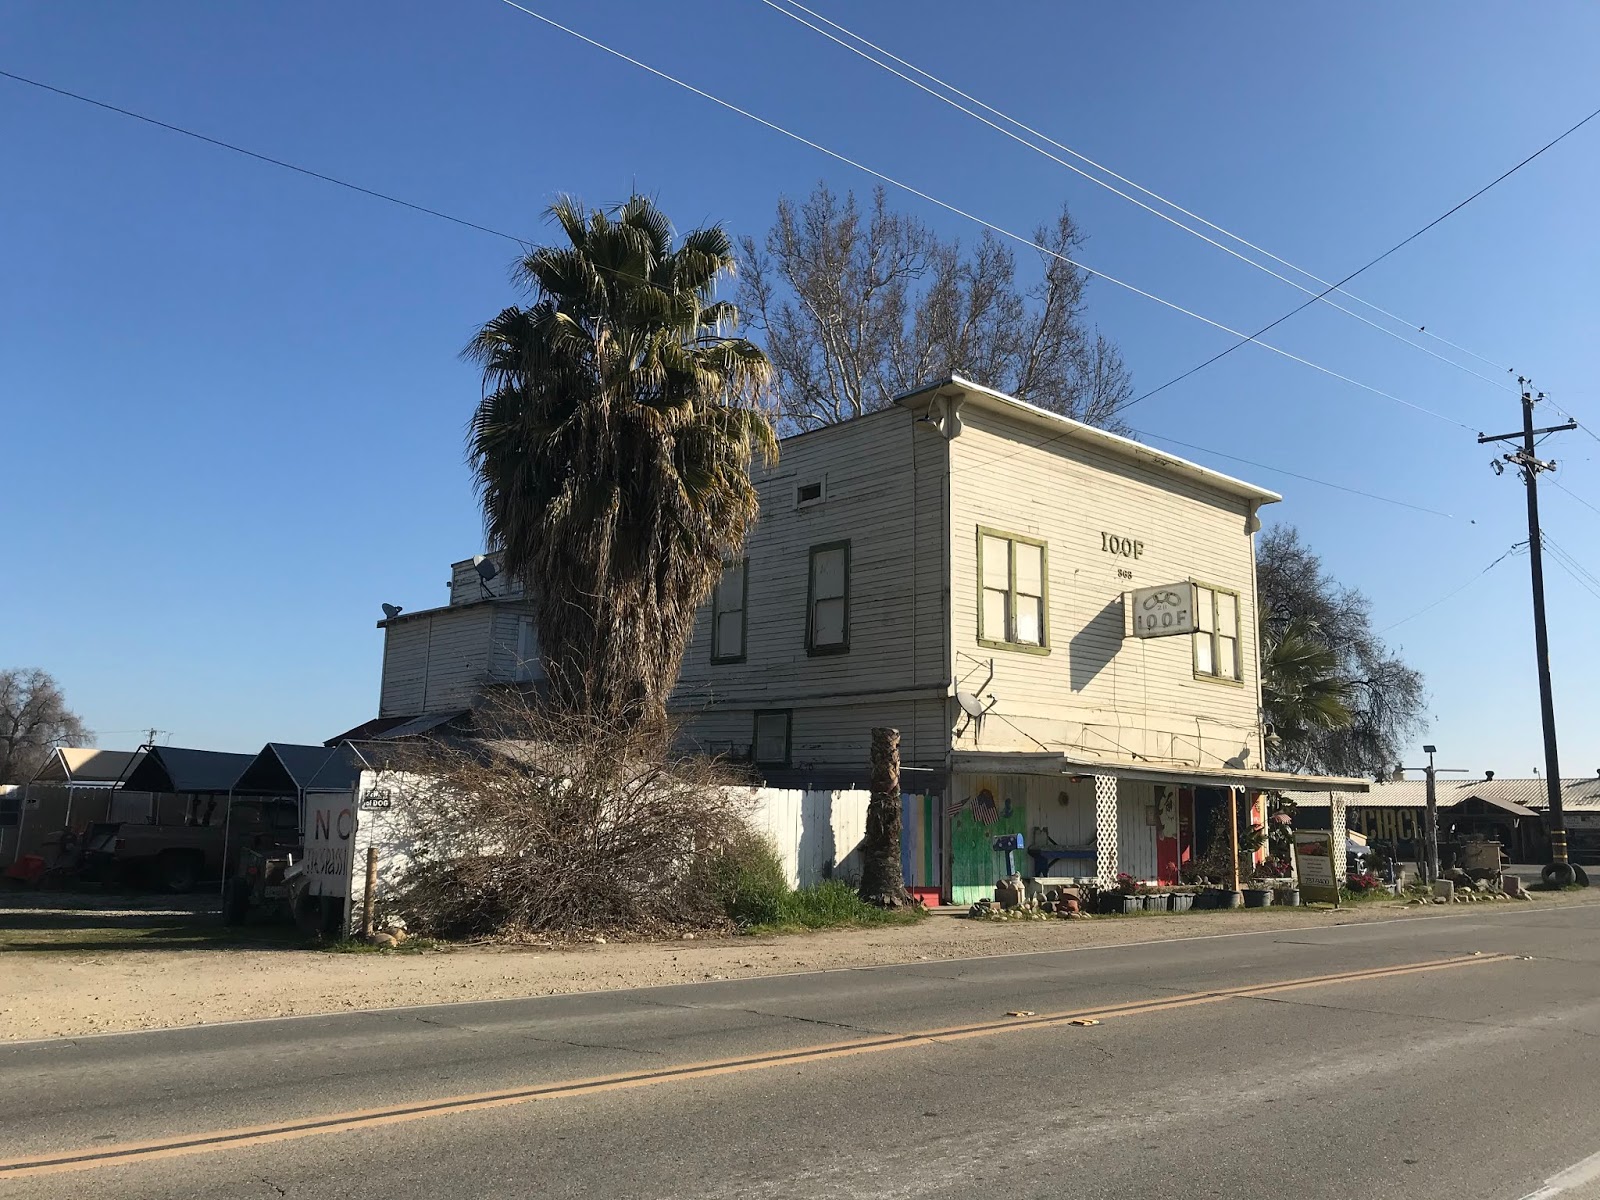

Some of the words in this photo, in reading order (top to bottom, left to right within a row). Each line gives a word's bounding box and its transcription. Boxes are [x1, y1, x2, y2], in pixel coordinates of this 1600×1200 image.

[1101, 531, 1144, 560] IOOF
[1138, 610, 1187, 631] IOOF
[373, 799, 389, 807] DOG
[315, 808, 352, 840] NO
[1361, 809, 1425, 840] CIRCL
